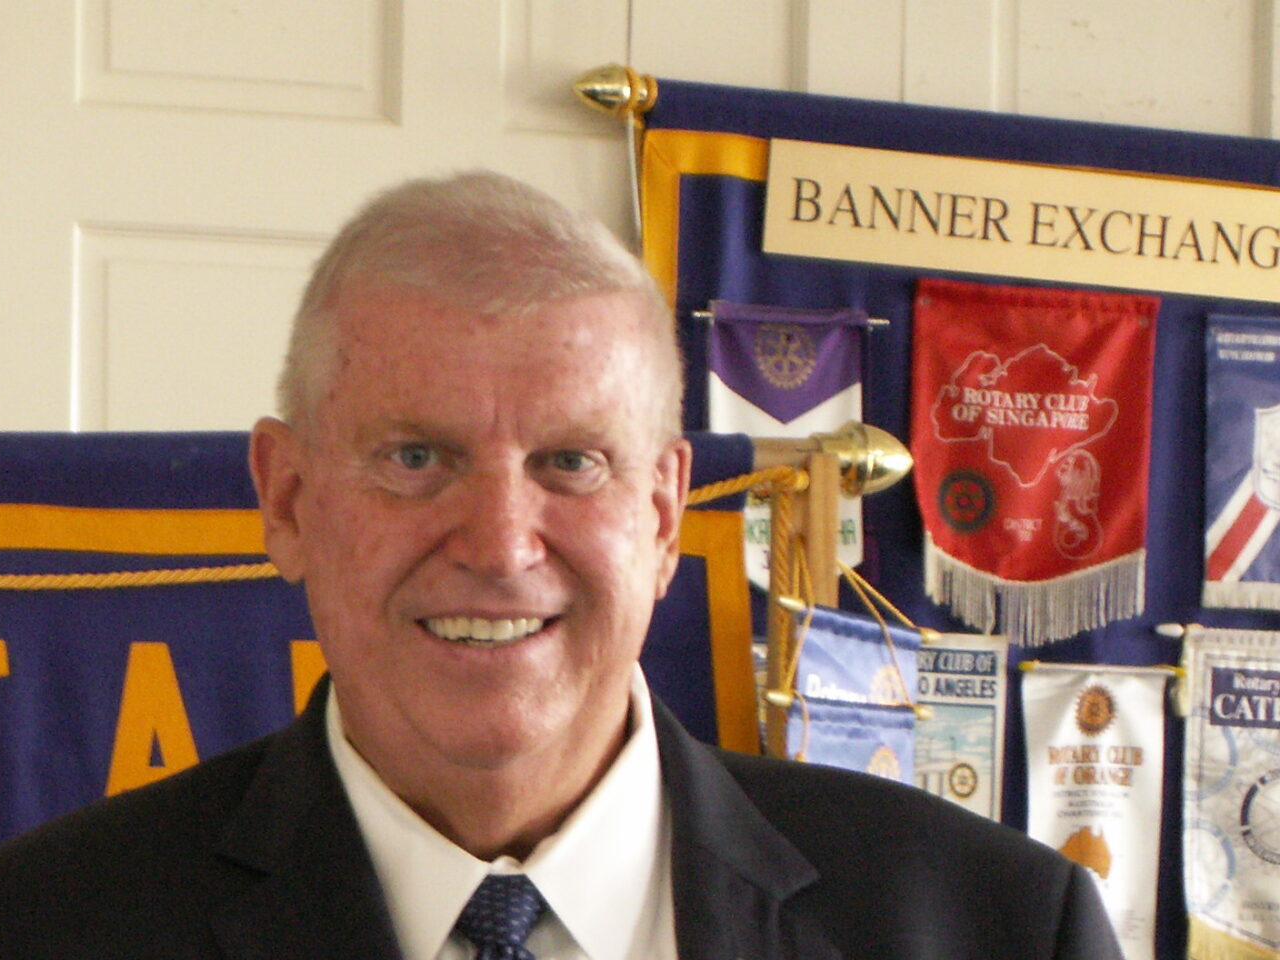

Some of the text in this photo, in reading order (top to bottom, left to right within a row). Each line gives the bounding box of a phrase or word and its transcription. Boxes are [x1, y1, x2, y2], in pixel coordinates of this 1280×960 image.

[791, 176, 1012, 244] BANNER
[963, 387, 1090, 412] ROTARY CLUB
[951, 404, 1090, 431] OF SINGAPORE
[938, 652, 975, 672] CLUB
[934, 677, 996, 699] ANGELES
